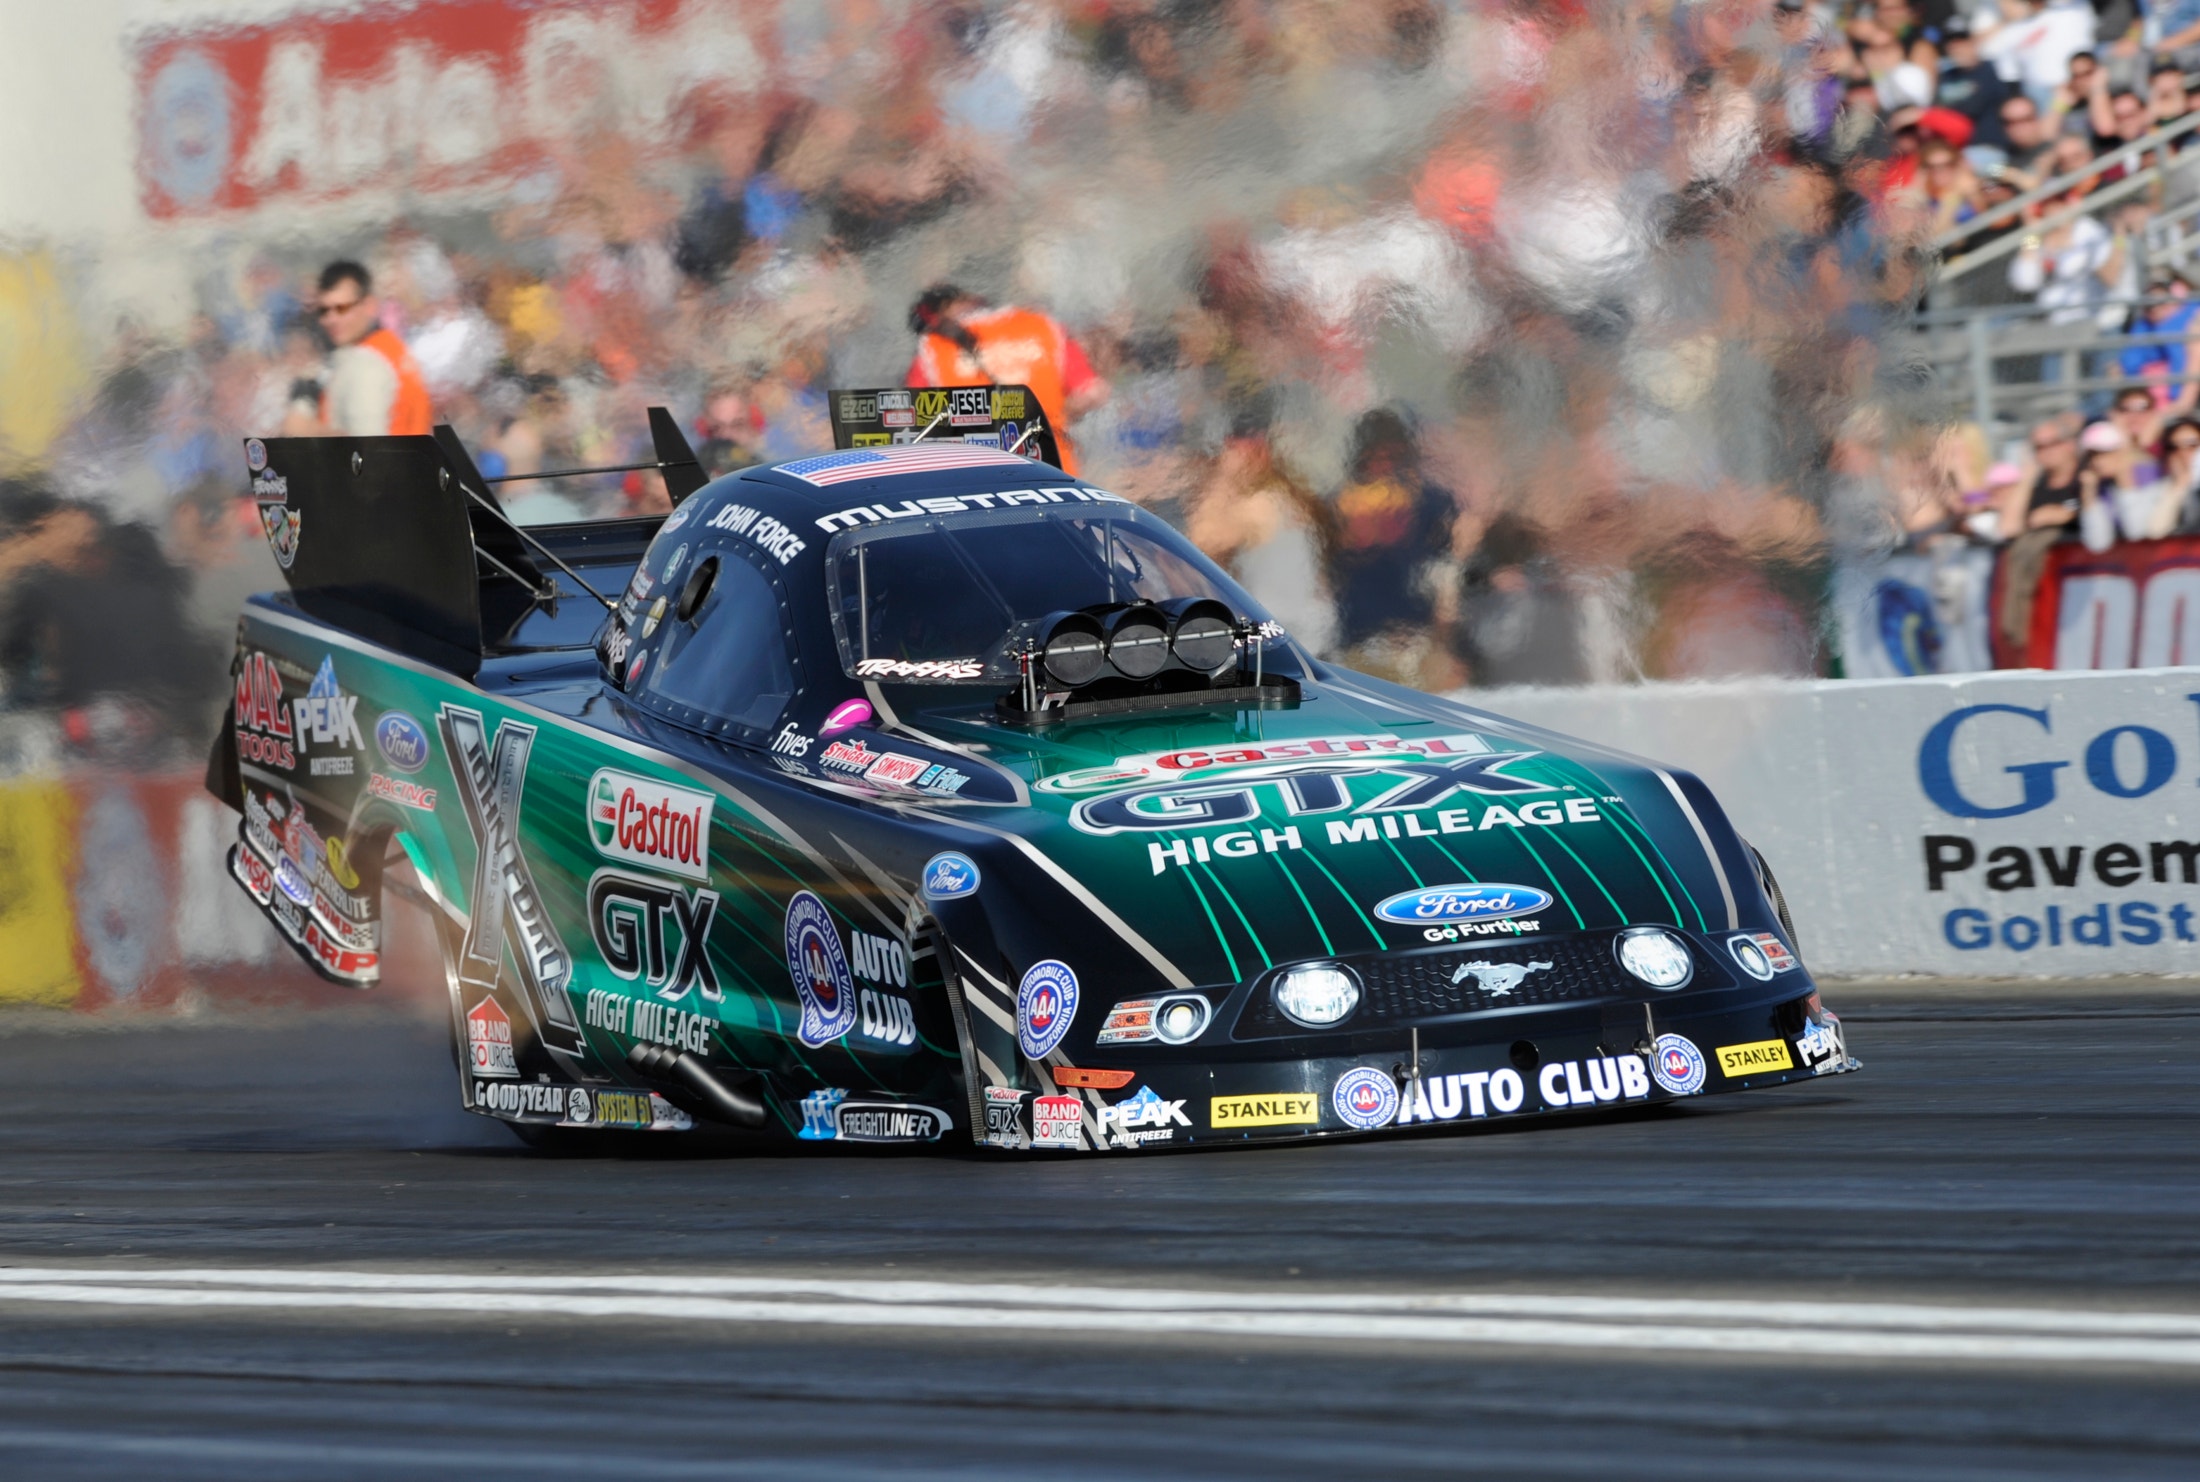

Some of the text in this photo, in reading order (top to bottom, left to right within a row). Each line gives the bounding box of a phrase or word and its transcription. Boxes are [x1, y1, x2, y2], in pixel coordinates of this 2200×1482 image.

[951, 392, 991, 415] JESEL
[815, 487, 1132, 533] MUSTANG
[706, 503, 761, 537] JOHN
[747, 516, 807, 566] FORCE
[856, 659, 984, 679] TRAXXAS
[235, 651, 292, 738] MAC
[293, 696, 365, 753] PEAK
[386, 719, 418, 762] Ford
[771, 722, 815, 757] fives
[236, 730, 296, 770] TOOLS
[310, 756, 354, 776] ANTIFREEZE
[824, 741, 877, 765] STINGRAY
[872, 757, 923, 780] SIMPSON
[1156, 737, 1468, 770] Castrol
[1918, 693, 2200, 819] Go
[368, 772, 438, 812] RACING
[464, 740, 510, 855] JOHN
[1068, 751, 1561, 837] GTX
[618, 787, 702, 866] Castrol
[1148, 826, 1302, 876] HIGH
[1325, 797, 1601, 844] MILEAGE
[241, 847, 272, 893] MSD
[930, 861, 969, 892] Ford
[315, 893, 353, 935] COMP
[1415, 889, 1516, 918] Ford
[587, 867, 722, 1002] GTX
[788, 900, 841, 962] AUTOMOBILE CLUB
[1423, 918, 1541, 943] Go Further
[1943, 901, 2197, 951] GoldSt
[305, 923, 378, 973] ARP
[852, 930, 907, 988] AUTO
[805, 949, 835, 988] AAA
[1021, 966, 1075, 1000] AUTOMOBILE CLUB
[791, 961, 854, 1039] SOUTHERN CALIFORNIA
[860, 988, 917, 1045] CLUB
[1029, 995, 1056, 1019] AAA
[469, 1019, 511, 1041] BRAND
[586, 988, 631, 1034] HIGH
[632, 998, 711, 1056] MILEAGE
[1019, 1006, 1073, 1055] SOUTHERN CALIFORNIA
[469, 1044, 517, 1069] SOURCE
[1665, 1055, 1689, 1071] AAA
[1680, 1041, 1697, 1058] CLUB
[1724, 1046, 1785, 1068] STANLEY
[1796, 1026, 1843, 1067] PEAK
[475, 1081, 564, 1118] GOODYEAR
[597, 1092, 637, 1122] SYSTEM
[1352, 1089, 1380, 1105] AAA
[1397, 1054, 1650, 1124] AUTO CLUB
[800, 1099, 835, 1134] PPG
[843, 1112, 932, 1137] FREIGHTLINER
[986, 1103, 1023, 1132] GTX
[1035, 1103, 1080, 1120] BRAND
[1097, 1099, 1193, 1135] PEAK
[1217, 1099, 1312, 1119] STANLEY
[1338, 1094, 1395, 1126] SOUTHERN CALIFORNIA
[1034, 1121, 1080, 1139] SOURCE
[1110, 1128, 1173, 1145] ANTIFREEZE
